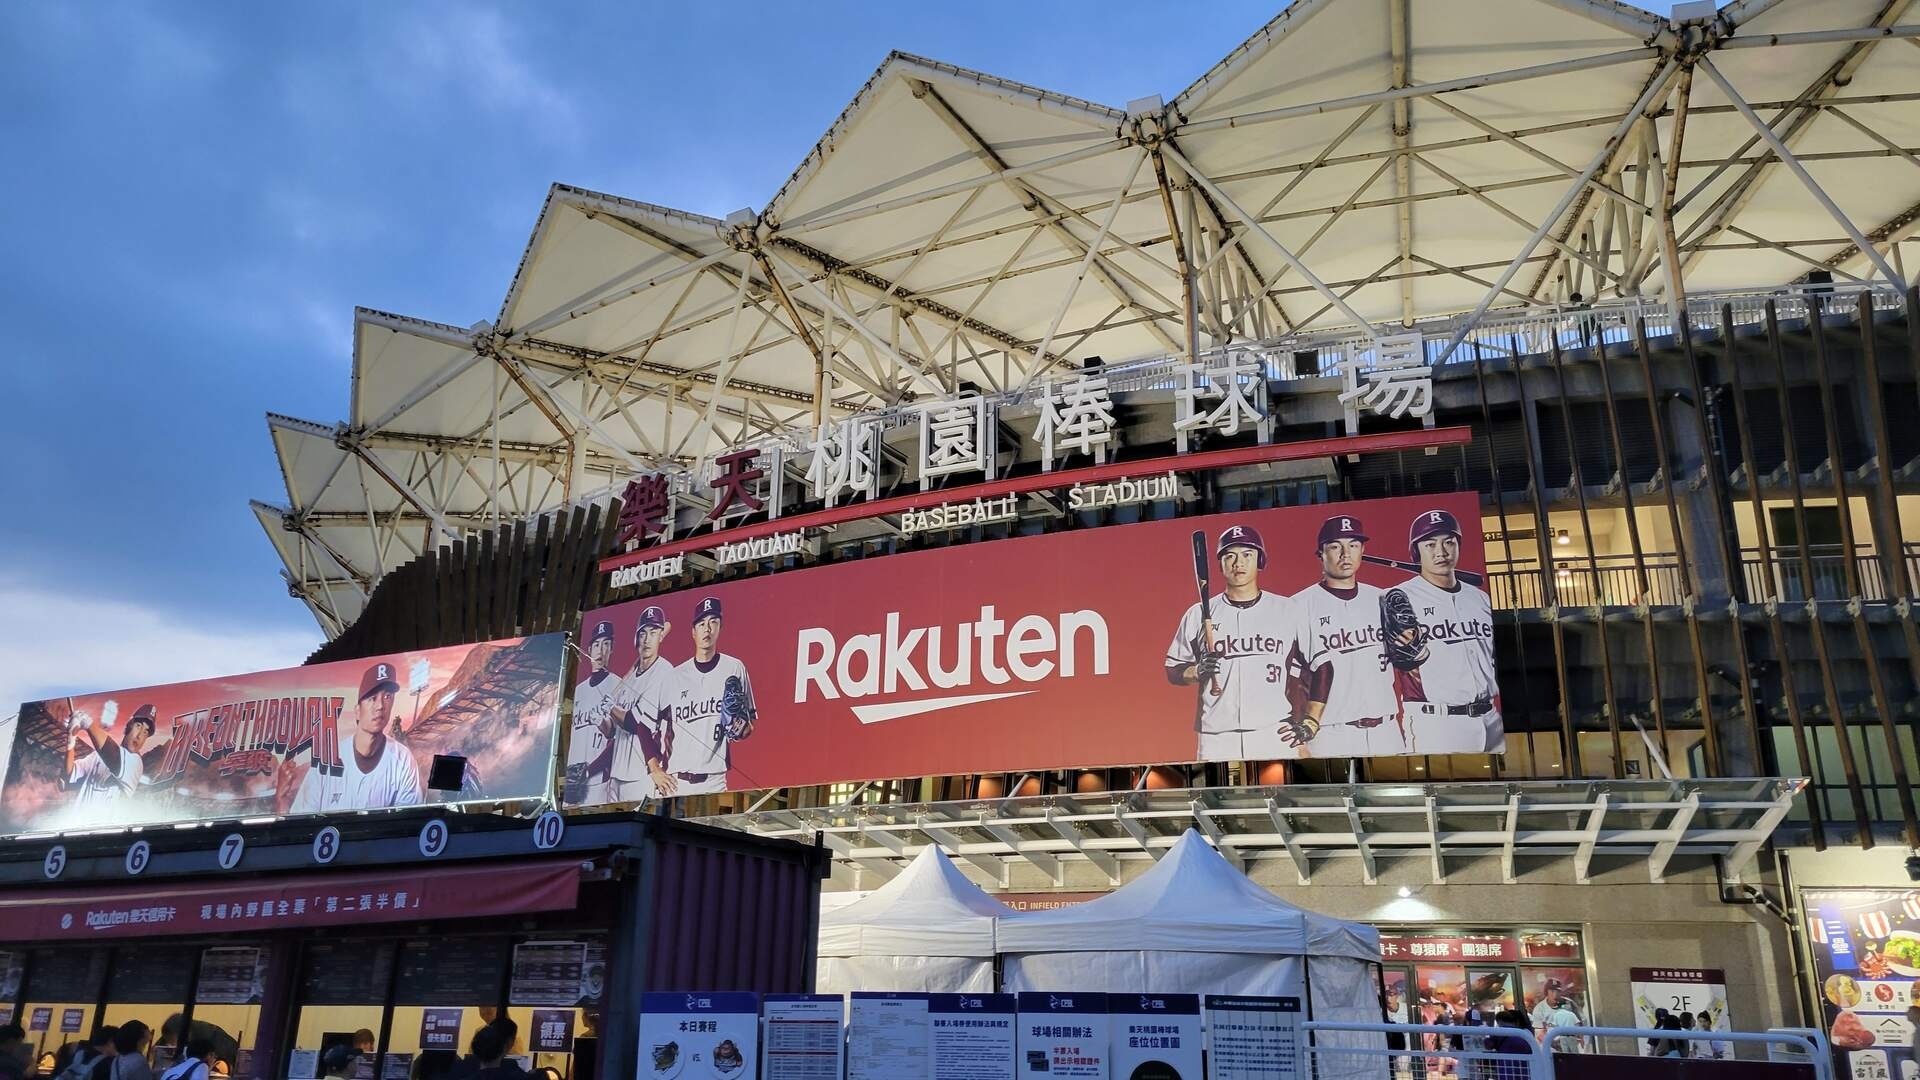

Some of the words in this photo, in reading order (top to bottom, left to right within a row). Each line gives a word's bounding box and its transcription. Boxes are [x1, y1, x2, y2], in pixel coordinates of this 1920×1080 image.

[610, 555, 683, 588] RAKUTEN
[718, 534, 798, 565] TAOYUAN
[901, 498, 1017, 532] BASEBALL
[1068, 475, 1178, 509] STADIUM
[795, 605, 1110, 704] Rakuten
[377, 664, 388, 680] R
[425, 824, 443, 852] 9
[537, 815, 560, 847] 10
[130, 845, 145, 870] 6
[223, 839, 240, 865] 7
[317, 832, 333, 859] 8
[47, 850, 62, 873] 5
[85, 909, 129, 926] Rakuten
[1030, 901, 1059, 910] INFIELD
[1671, 995, 1692, 1011] 2F
